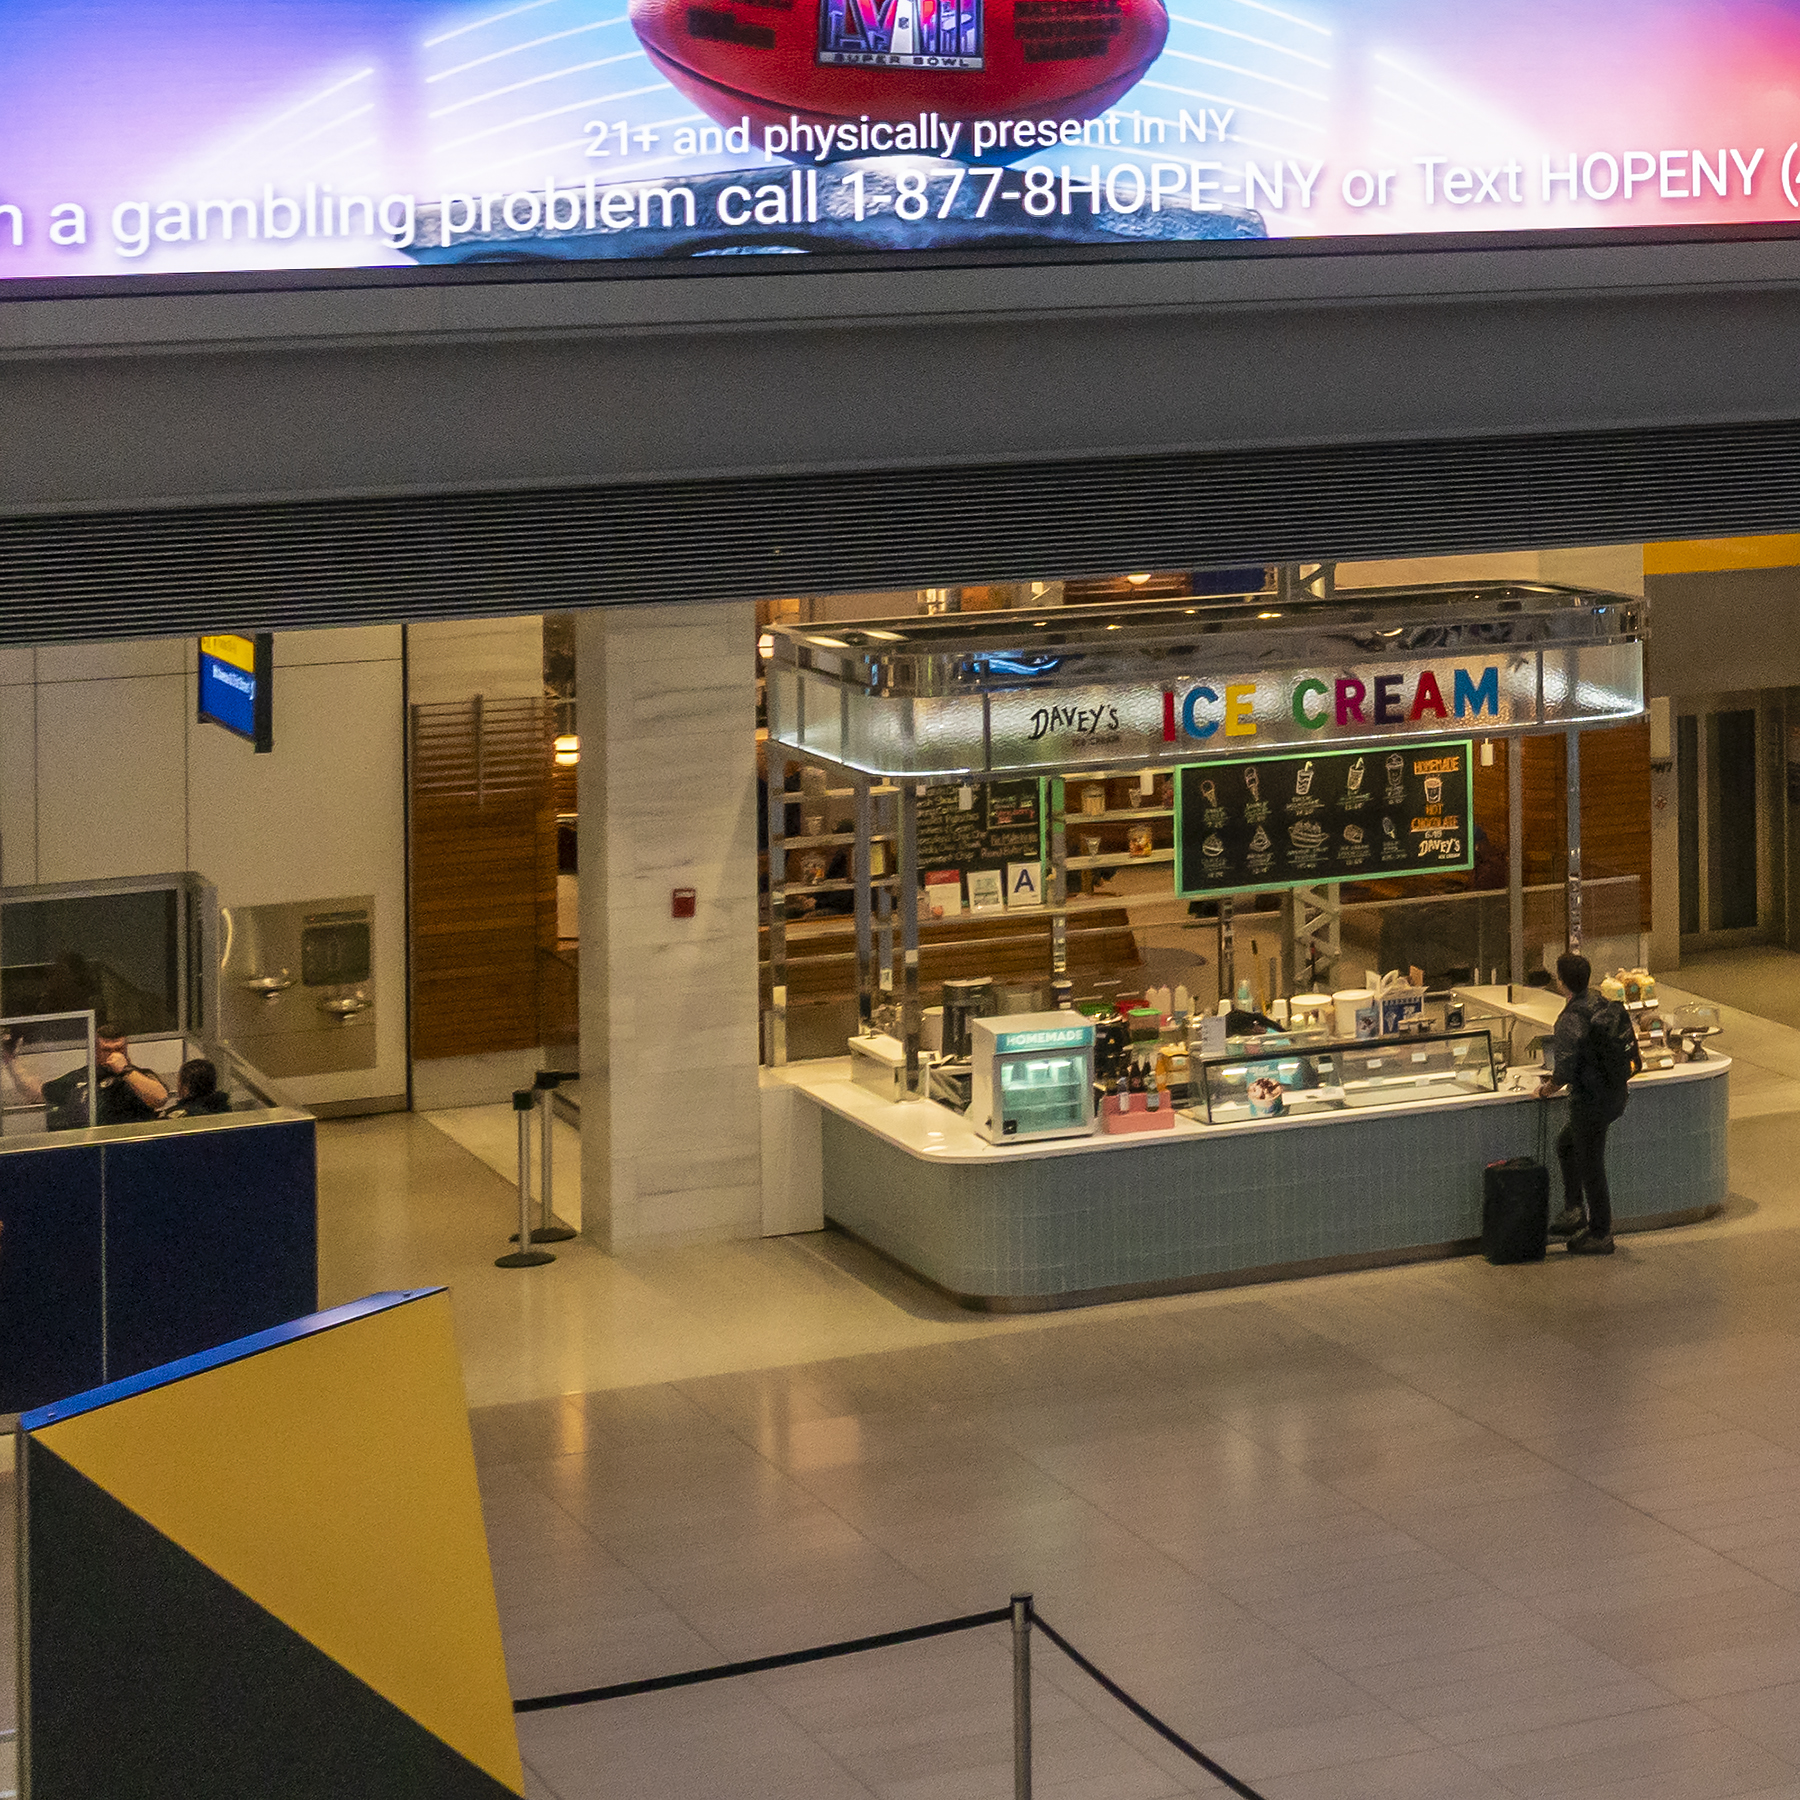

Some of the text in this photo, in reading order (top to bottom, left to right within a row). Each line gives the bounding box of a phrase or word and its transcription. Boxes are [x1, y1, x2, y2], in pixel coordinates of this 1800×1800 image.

[833, 53, 970, 69] SUPER BOWL
[584, 120, 660, 158] 21+
[673, 116, 750, 156] and
[764, 112, 962, 162] physically
[974, 112, 1121, 156] present
[1133, 110, 1166, 146] in
[49, 202, 87, 246] a
[112, 177, 415, 258] gambling
[440, 174, 695, 246] problem
[717, 170, 817, 227] call
[841, 159, 1324, 222] 1-877-8HOPE-NY
[1341, 168, 1398, 209] or
[1415, 156, 1523, 205] Text
[1541, 148, 1764, 201] HOPENY
[1162, 666, 1500, 743] ICE CREAM
[1028, 704, 1120, 740] DAVEY'S
[1425, 803, 1444, 816] HOT
[1417, 838, 1461, 858] DAVEY'S
[1013, 868, 1035, 894] A
[1006, 1029, 1084, 1046] HOMEMADE
